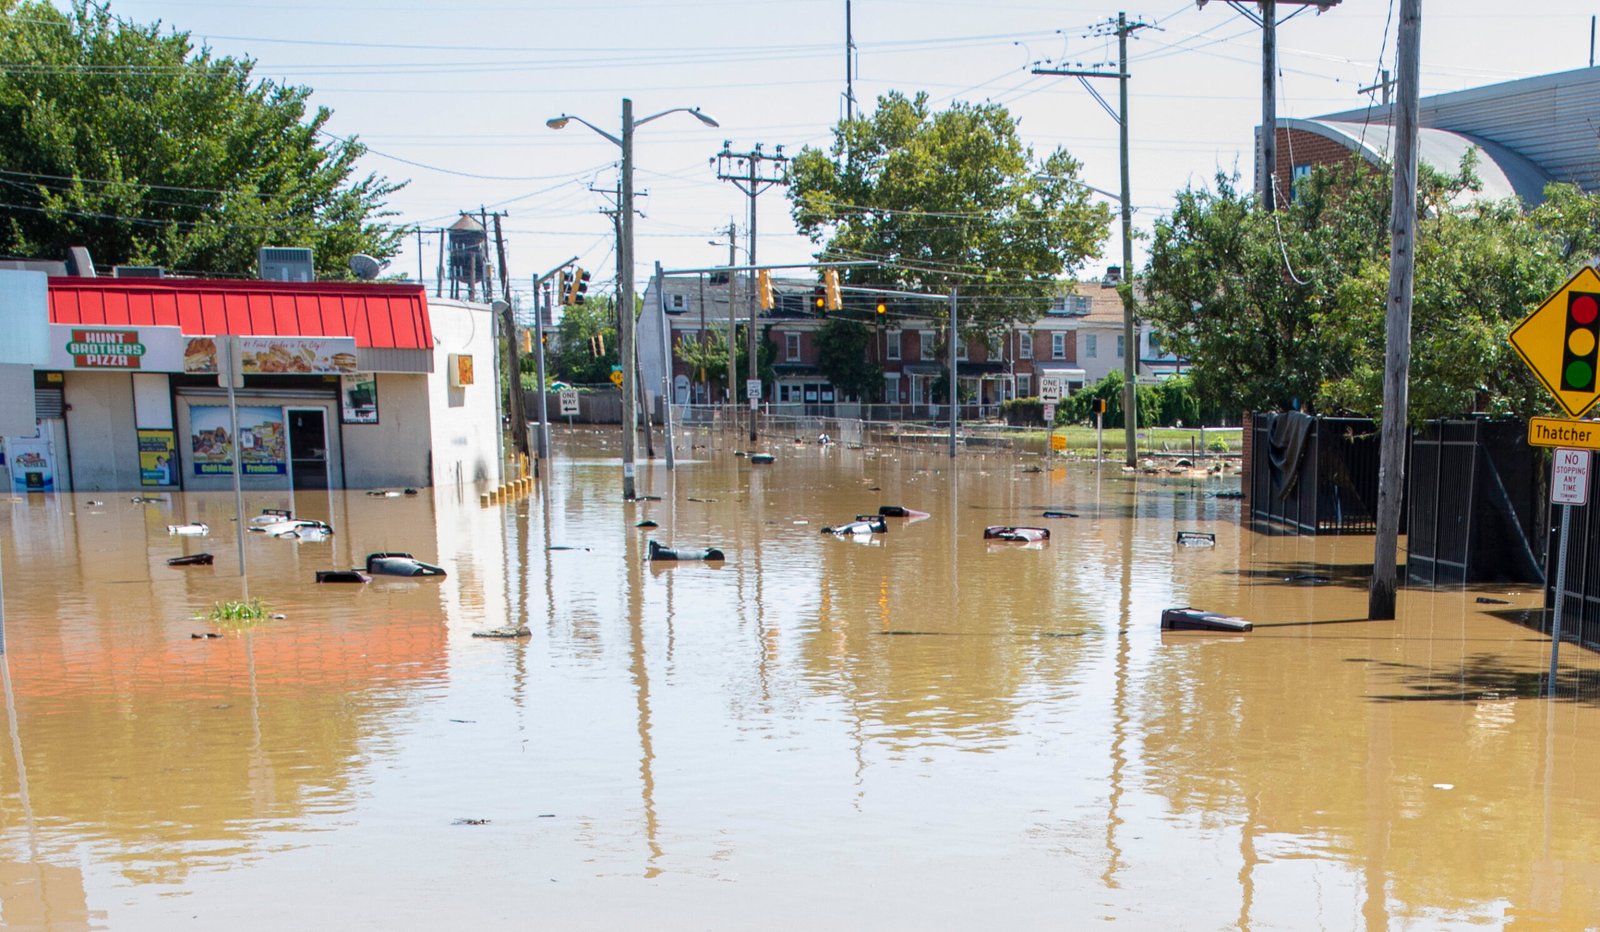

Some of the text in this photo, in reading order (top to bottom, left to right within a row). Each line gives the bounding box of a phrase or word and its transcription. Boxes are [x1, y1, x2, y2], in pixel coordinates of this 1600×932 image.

[85, 332, 126, 344] HUNT
[70, 343, 142, 355] BROTHERS
[86, 354, 129, 366] PIZZA
[1042, 379, 1058, 387] ONE
[749, 389, 760, 397] 25
[1536, 425, 1592, 442] Thatcher
[1564, 454, 1579, 465] NO
[1556, 466, 1586, 475] STOPPING
[1563, 475, 1577, 483] ANY
[1562, 484, 1577, 492] TIME
